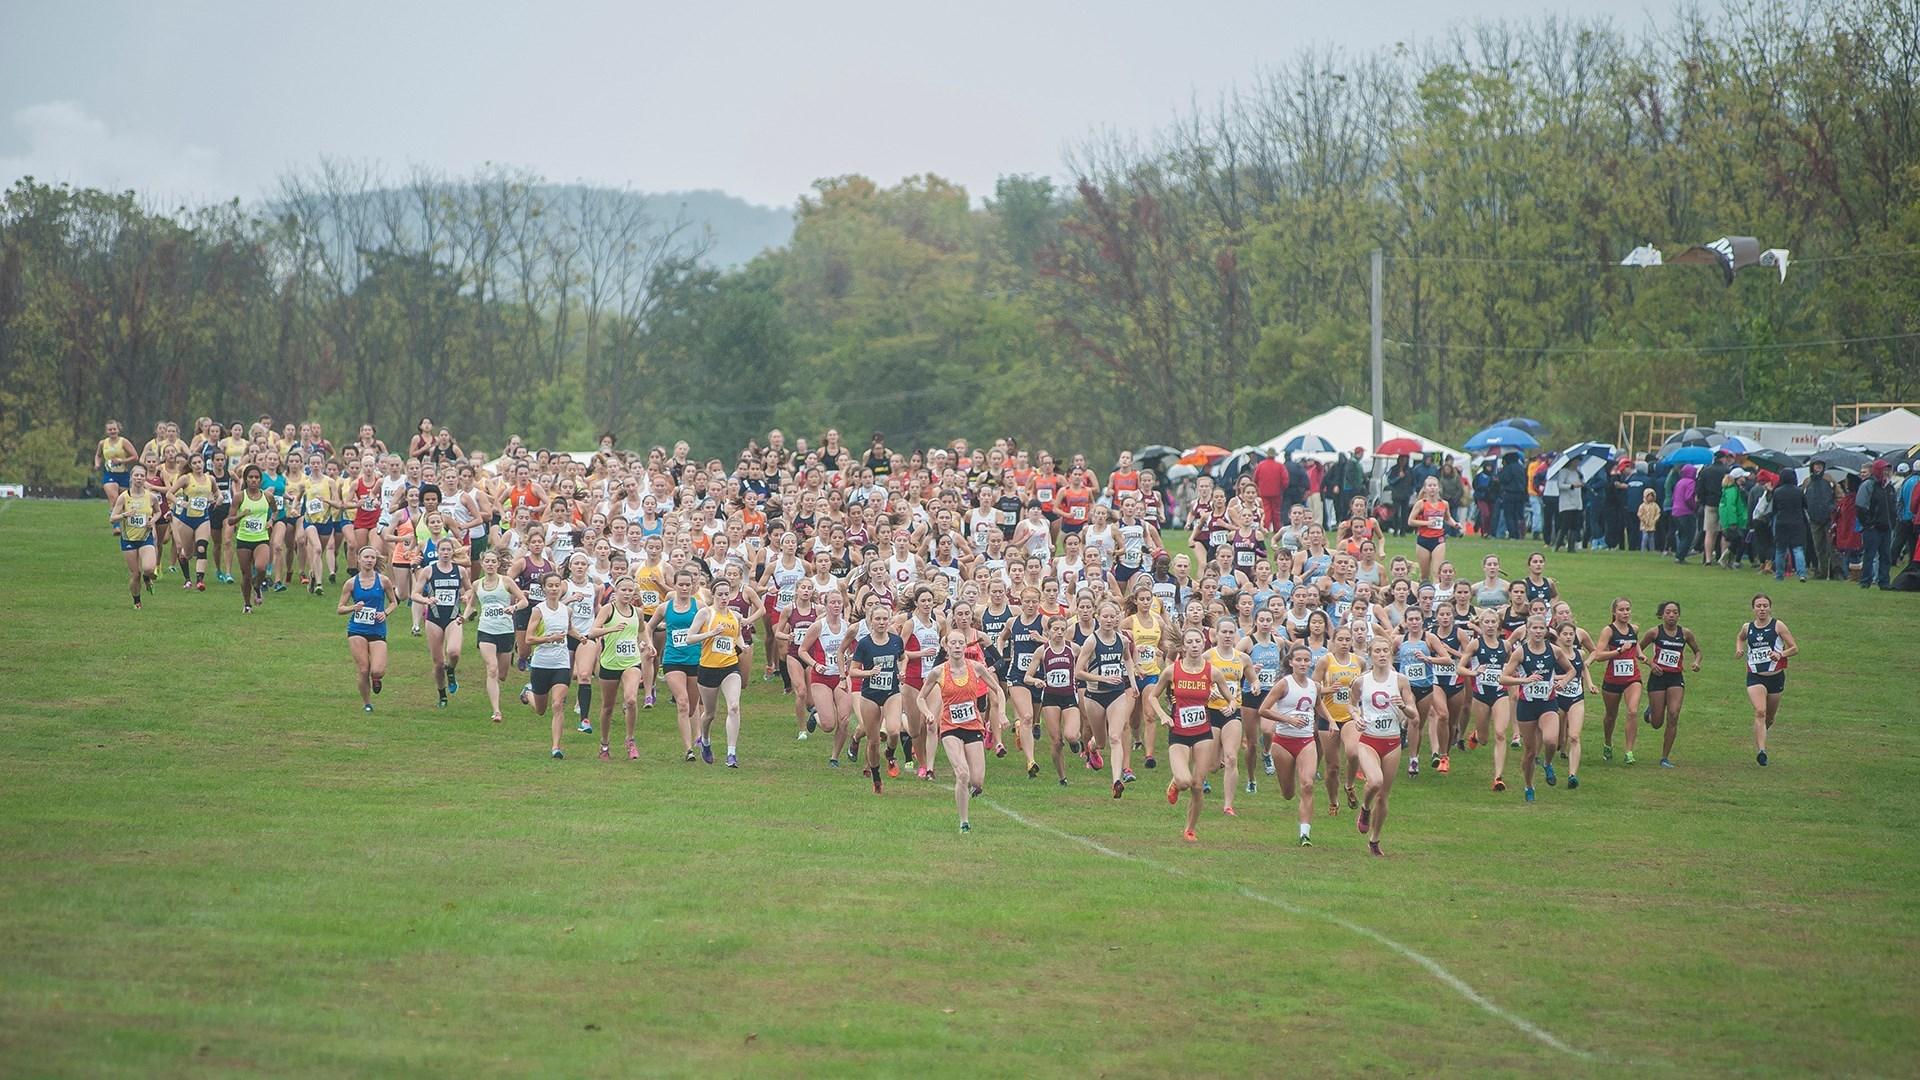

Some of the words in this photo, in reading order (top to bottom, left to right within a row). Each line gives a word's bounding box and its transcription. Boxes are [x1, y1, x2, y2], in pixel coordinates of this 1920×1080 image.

[245, 520, 262, 530] 5821
[896, 568, 909, 582] C
[438, 594, 453, 603] 475
[642, 594, 657, 603] 593
[355, 609, 375, 621] 5713
[577, 605, 592, 615] 795
[1015, 634, 1031, 642] NAV
[616, 644, 636, 654] 5815
[716, 640, 731, 650] 600
[1100, 653, 1122, 661] NAVY
[1408, 668, 1423, 677] 633
[1050, 674, 1067, 684] 712
[1178, 680, 1206, 691] GUELPH
[1371, 691, 1390, 710] C
[951, 705, 974, 719] 5811
[1182, 711, 1205, 724] 1370
[1375, 719, 1393, 730] 307
